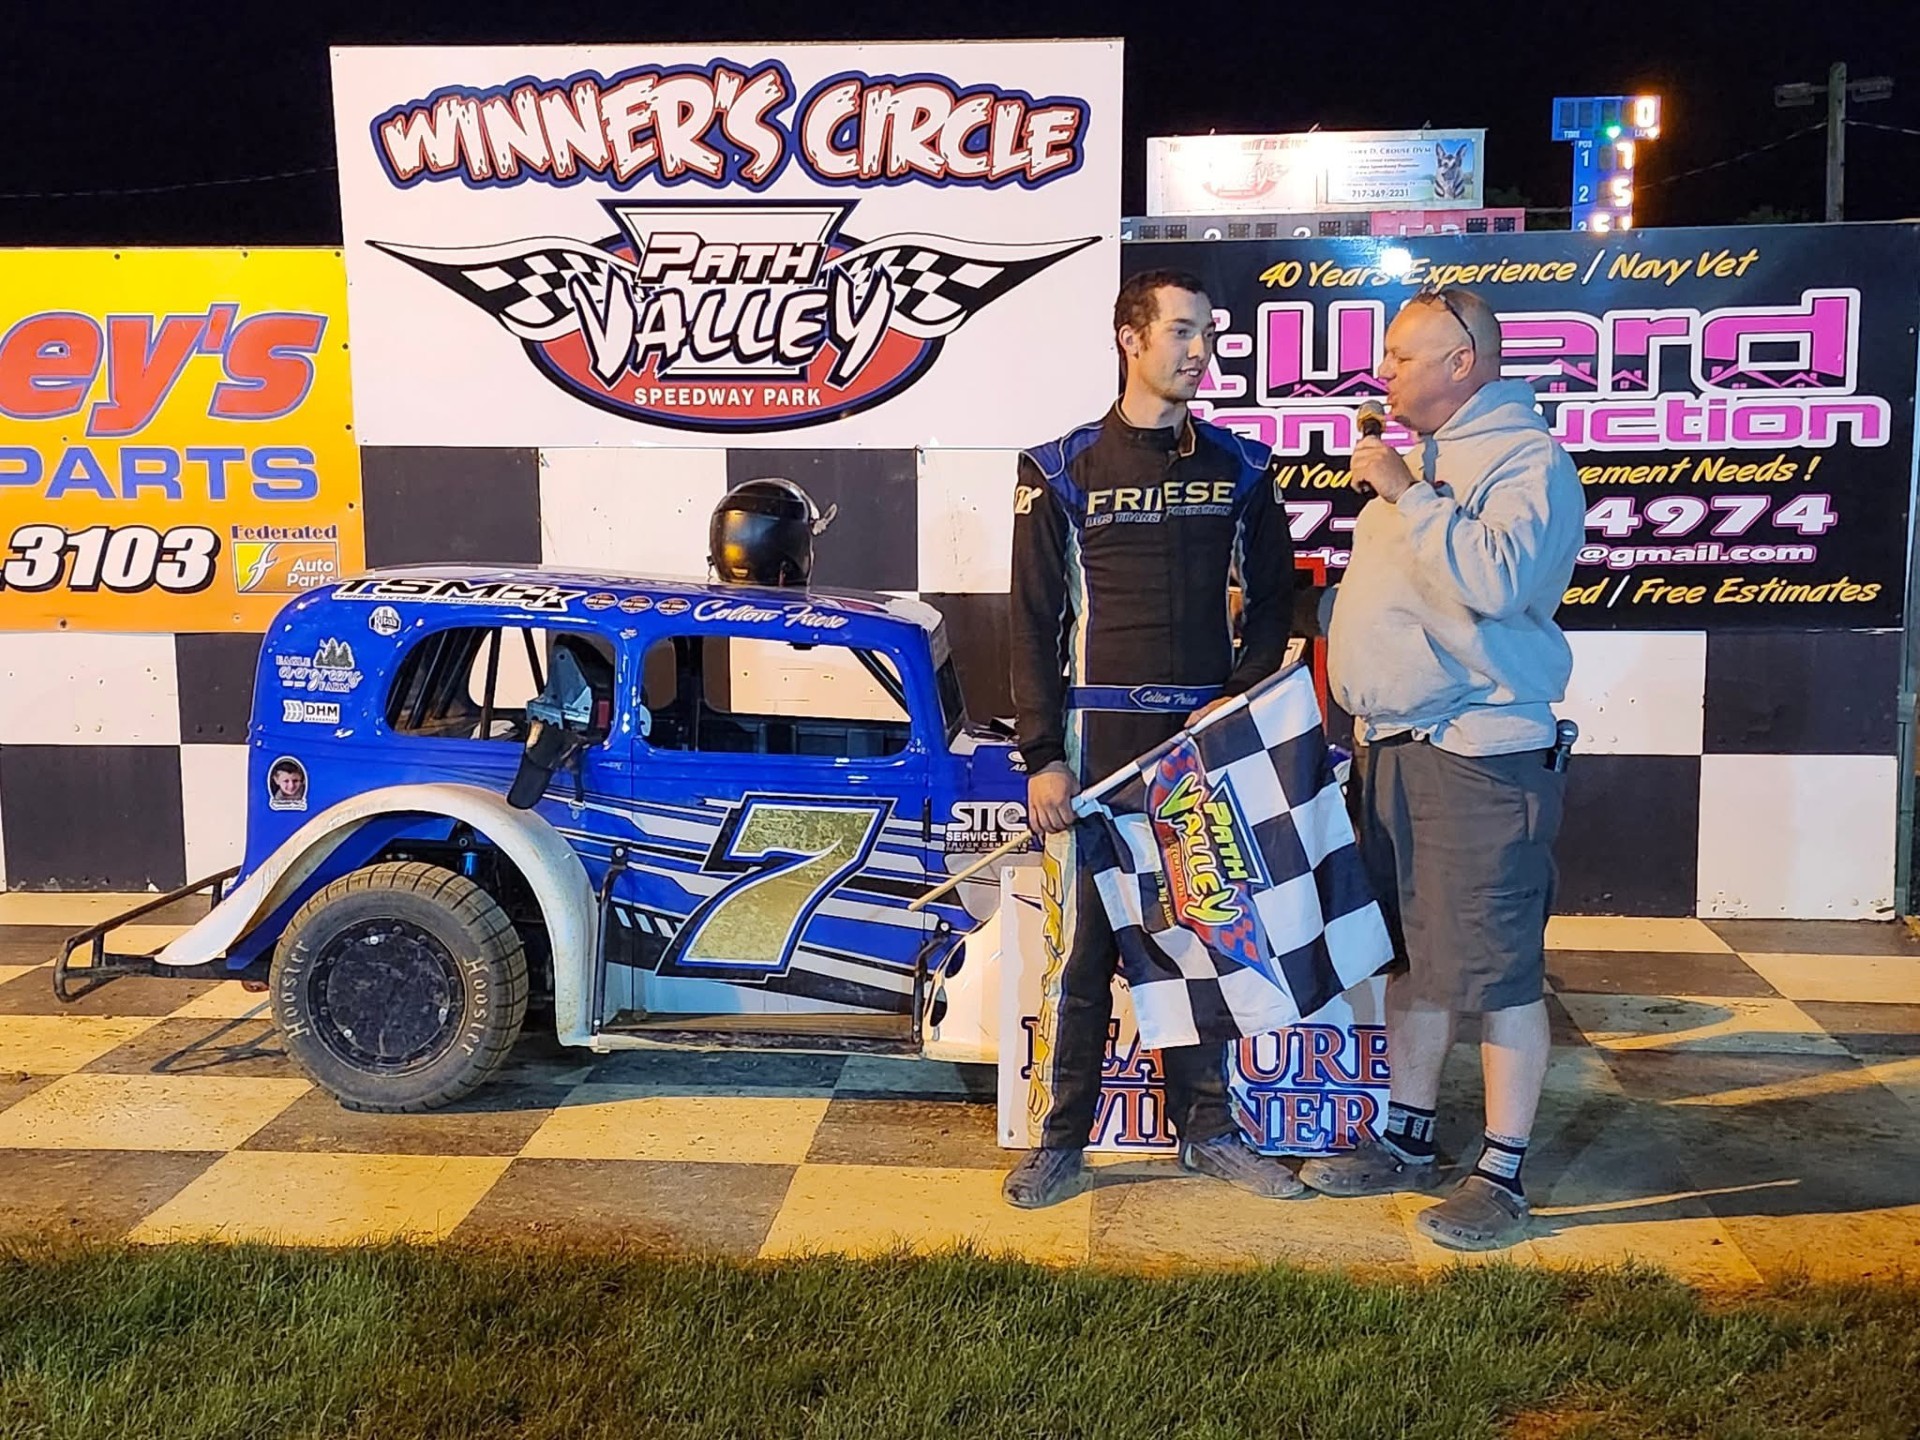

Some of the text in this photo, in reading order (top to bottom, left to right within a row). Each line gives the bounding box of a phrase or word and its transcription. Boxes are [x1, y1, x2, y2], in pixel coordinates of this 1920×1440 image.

[381, 65, 1083, 185] WINNER'S CIRCLE
[1380, 147, 1410, 155] CROUSE
[1351, 188, 1410, 198] 717-369-2231
[1579, 185, 1590, 203] 2
[637, 231, 828, 284] PATH
[1258, 260, 1302, 288] 40
[1305, 259, 1389, 287] Years
[1401, 257, 1578, 292] Experience
[1607, 251, 1693, 287] Navy
[1695, 248, 1760, 278] Vet
[569, 262, 894, 388] VALLEY
[634, 387, 822, 406] SPEEDWAY PARK
[1193, 396, 1890, 456] onuction
[0, 446, 320, 500] PARTS
[1271, 463, 1298, 489] ll
[1300, 463, 1353, 489] You
[1692, 454, 1798, 485] Needs
[231, 525, 337, 539] Federated
[287, 573, 336, 587] Parts
[292, 559, 334, 572] Auto
[1632, 577, 1707, 606] Free
[1712, 575, 1883, 604] Estimates
[305, 704, 339, 717] DHM
[945, 831, 1029, 842] SERVICE TIR
[1158, 774, 1243, 924] VALLEY
[1203, 801, 1250, 880] PATH
[674, 798, 883, 970] 7
